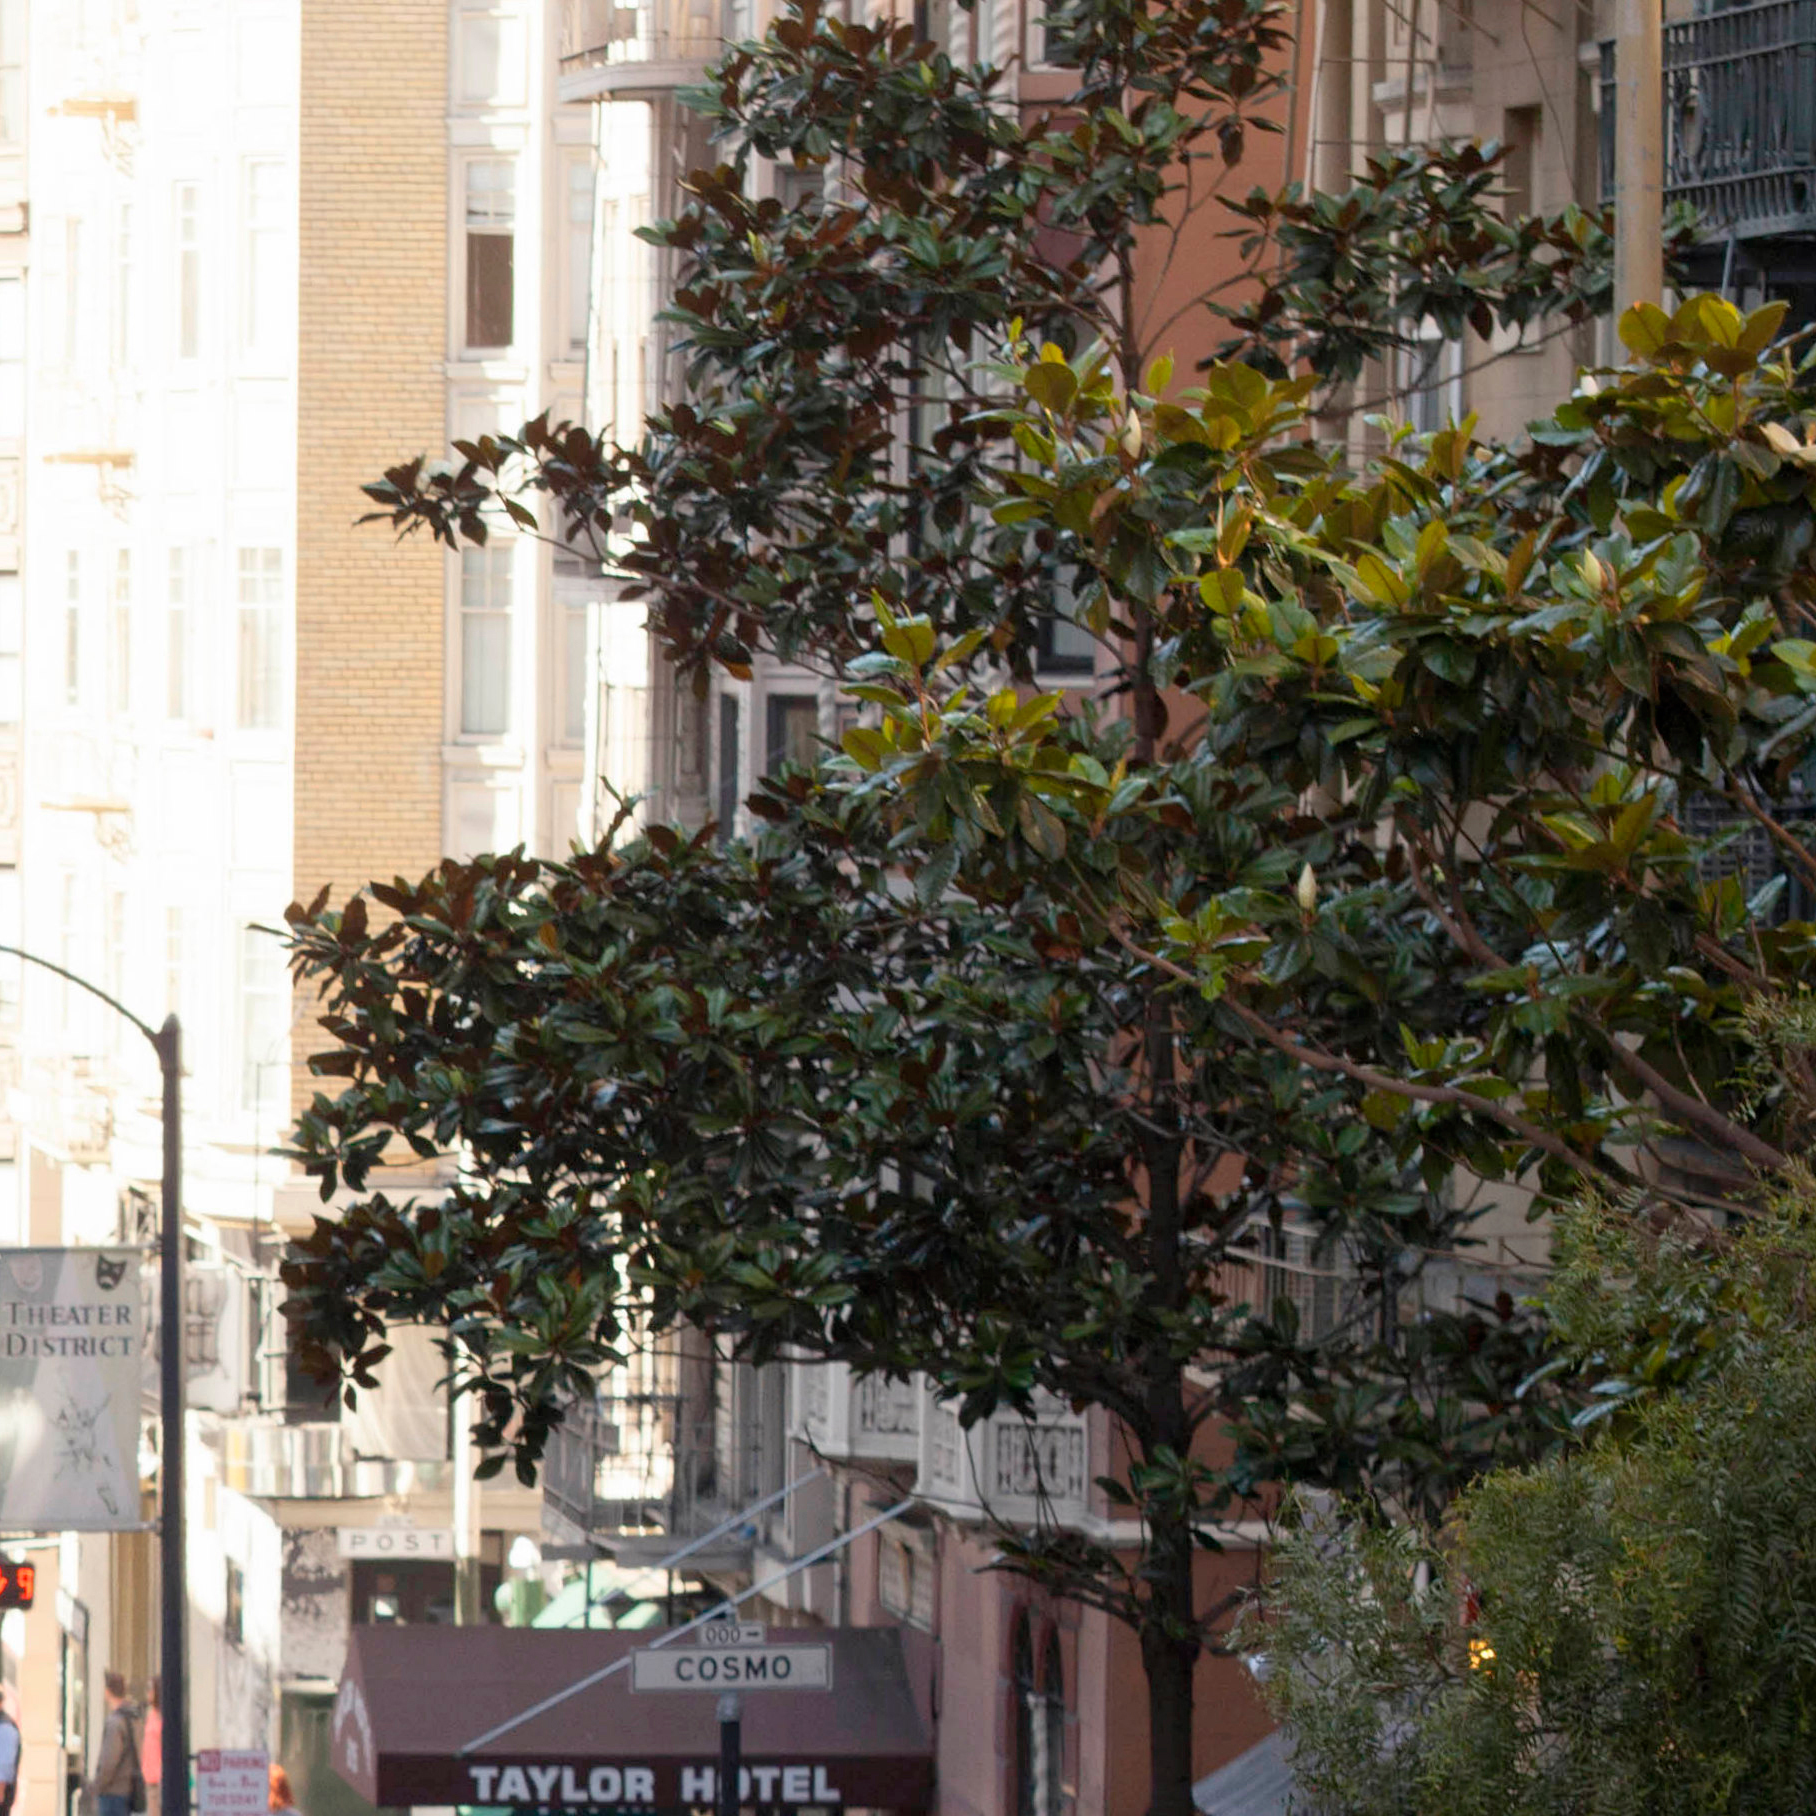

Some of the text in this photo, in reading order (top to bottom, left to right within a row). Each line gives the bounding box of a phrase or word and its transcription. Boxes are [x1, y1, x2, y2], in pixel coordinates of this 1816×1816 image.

[8, 1302, 132, 1326] THEATER
[6, 1333, 134, 1357] DISTRICT
[350, 1534, 444, 1551] POST
[16, 1566, 35, 1601] 9
[705, 1627, 742, 1644] 000
[675, 1655, 792, 1681] COSMO
[470, 1766, 655, 1801] TAYLOR
